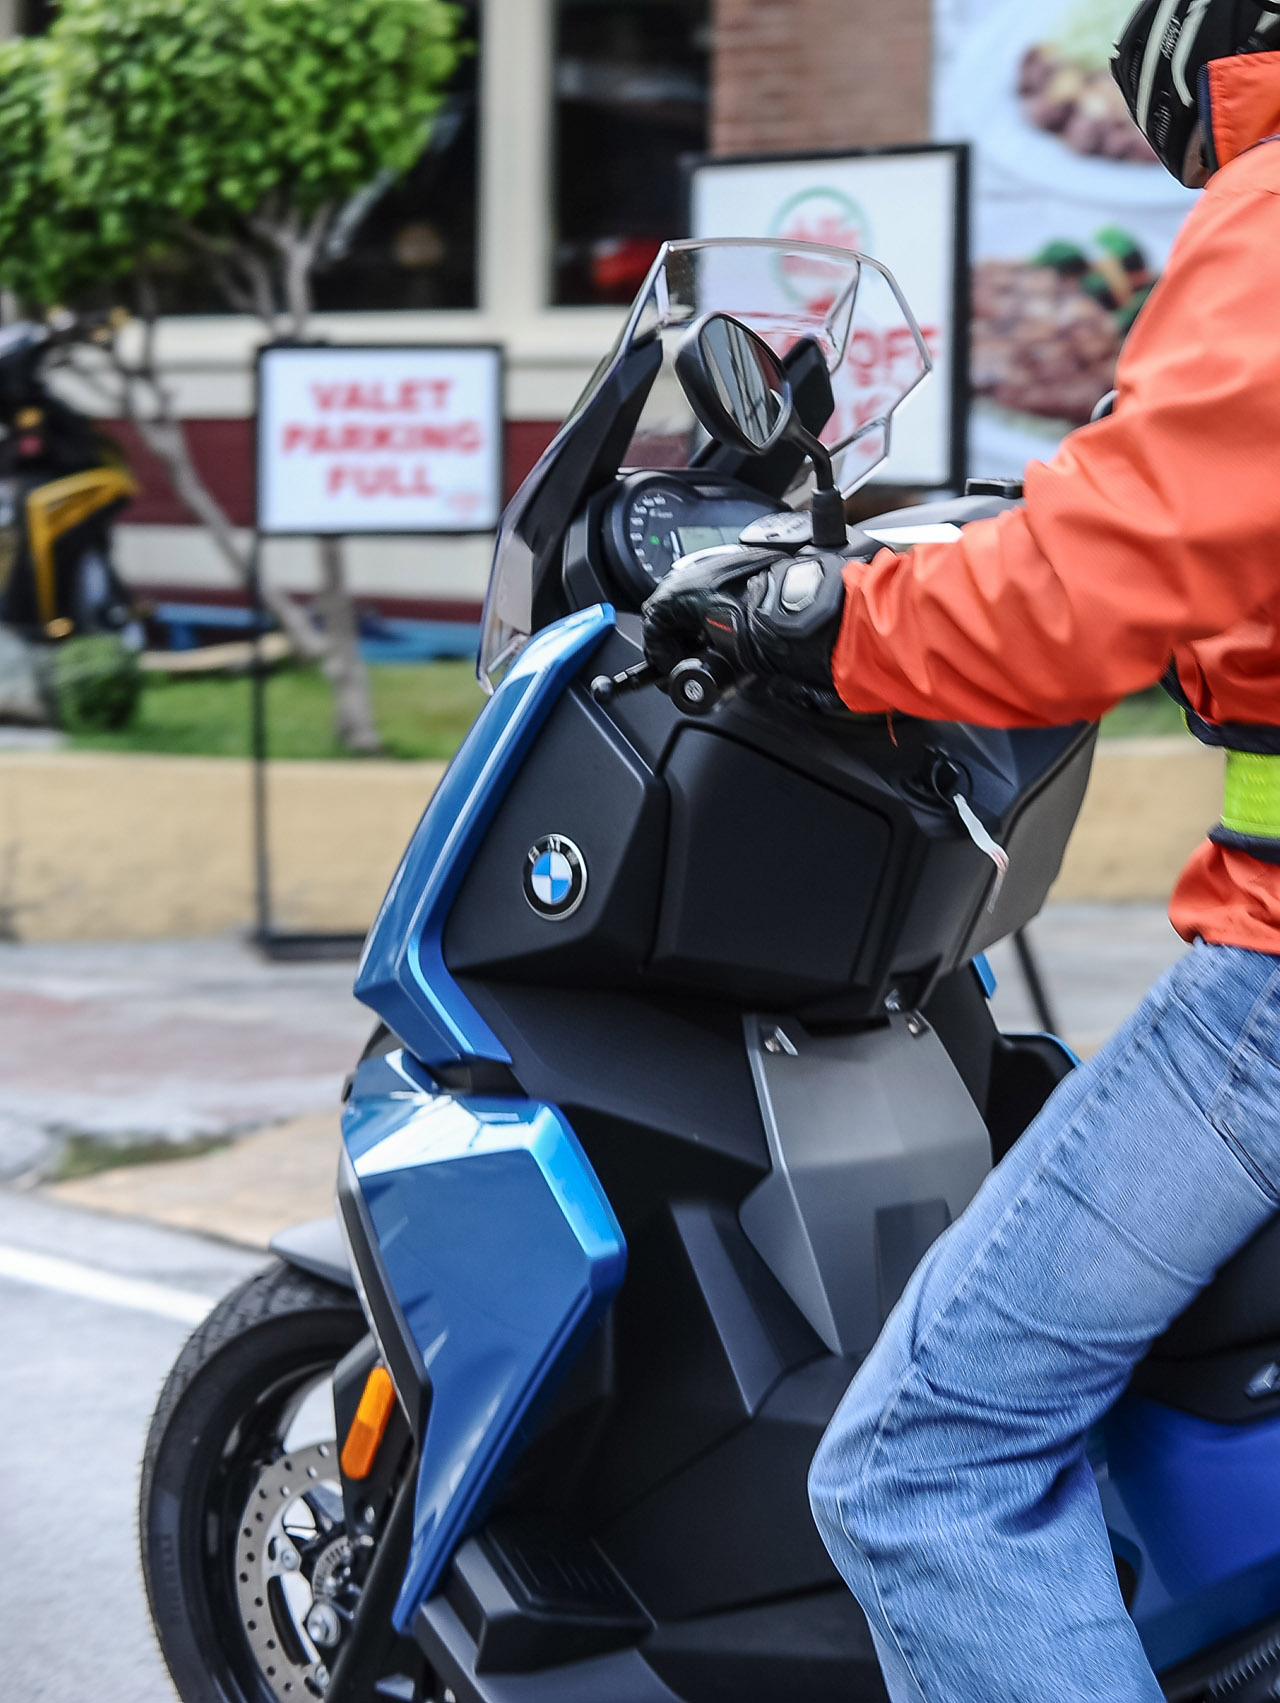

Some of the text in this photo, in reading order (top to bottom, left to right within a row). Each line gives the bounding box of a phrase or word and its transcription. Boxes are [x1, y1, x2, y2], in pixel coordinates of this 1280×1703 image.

[310, 379, 453, 412] VALET
[283, 420, 483, 454] PARKING
[325, 466, 437, 499] FULL
